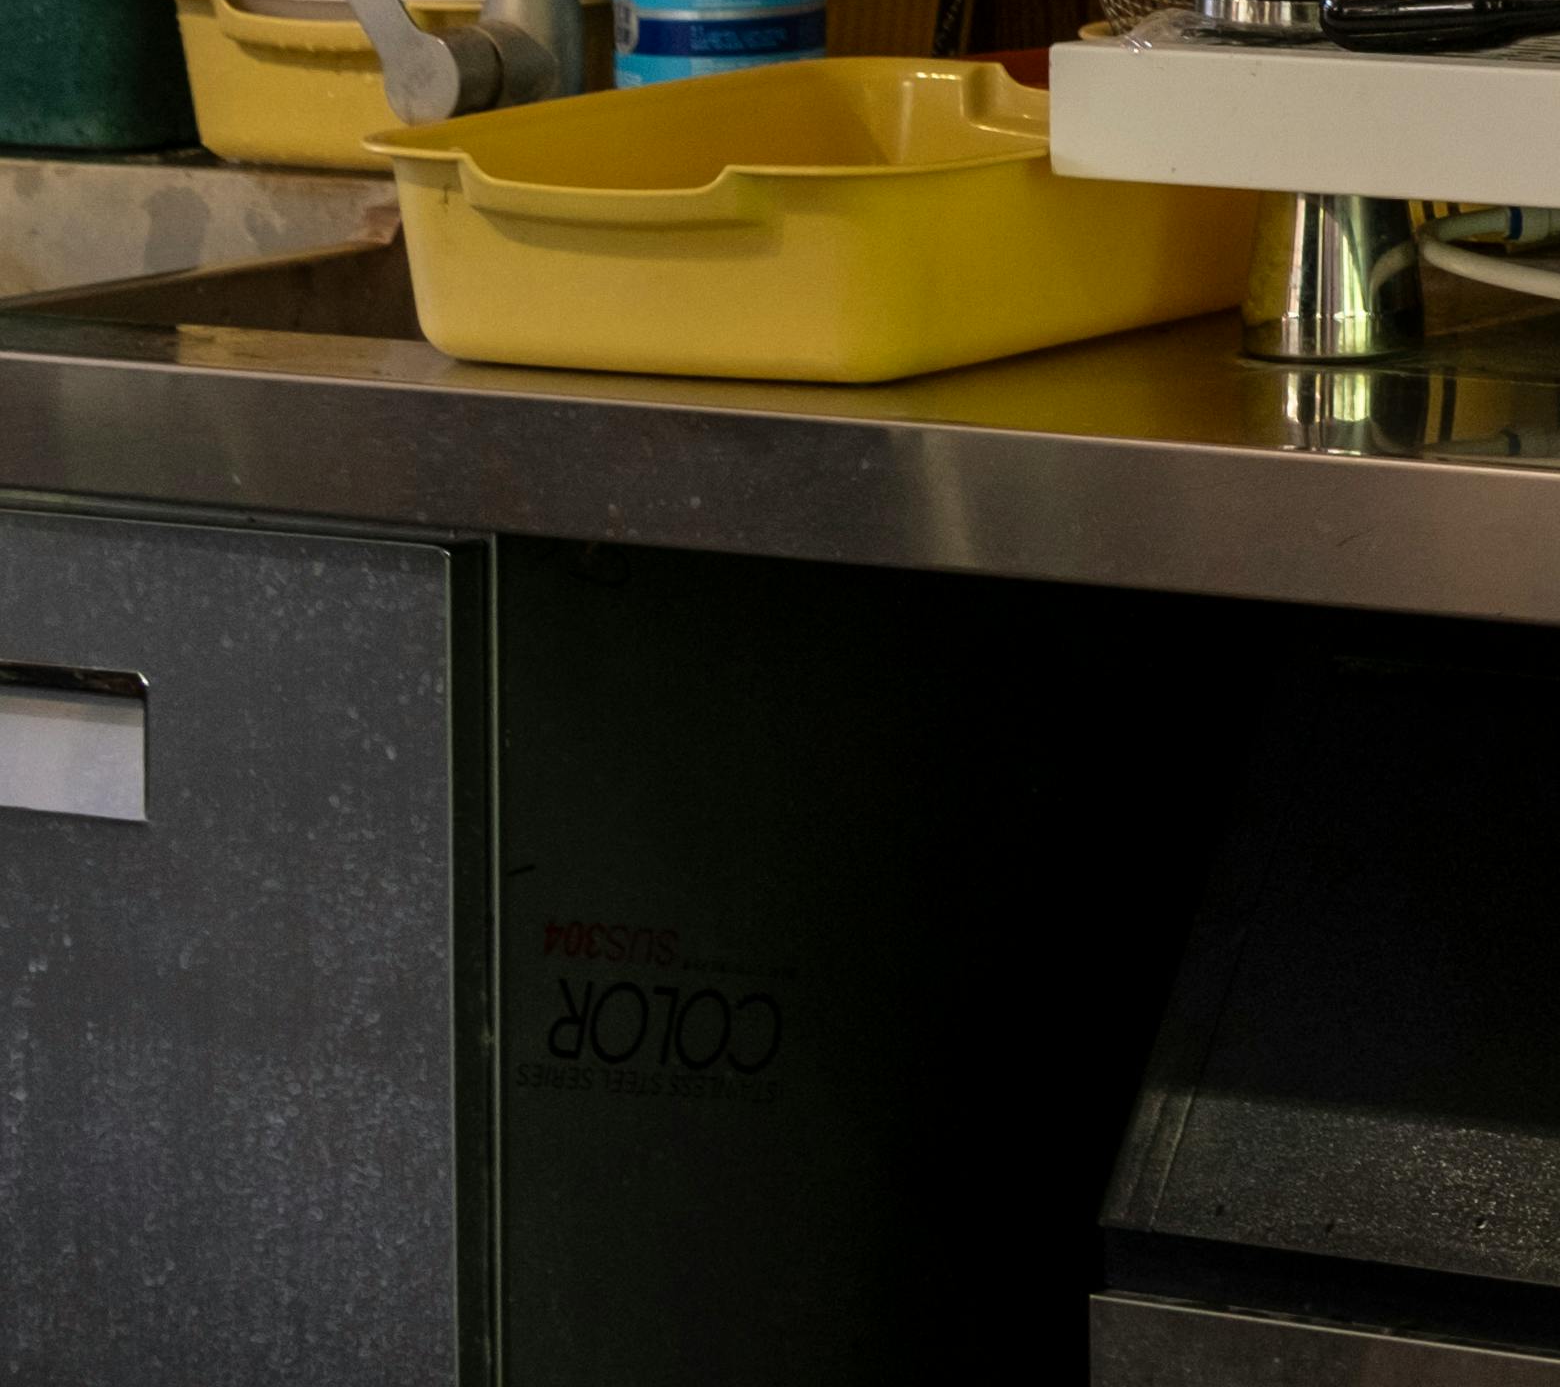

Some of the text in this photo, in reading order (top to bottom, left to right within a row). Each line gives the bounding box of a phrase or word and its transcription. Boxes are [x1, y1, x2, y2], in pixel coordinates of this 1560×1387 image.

[544, 920, 679, 967] SUS304
[548, 978, 783, 1075] COLOR
[516, 1063, 593, 1091] SERIES
